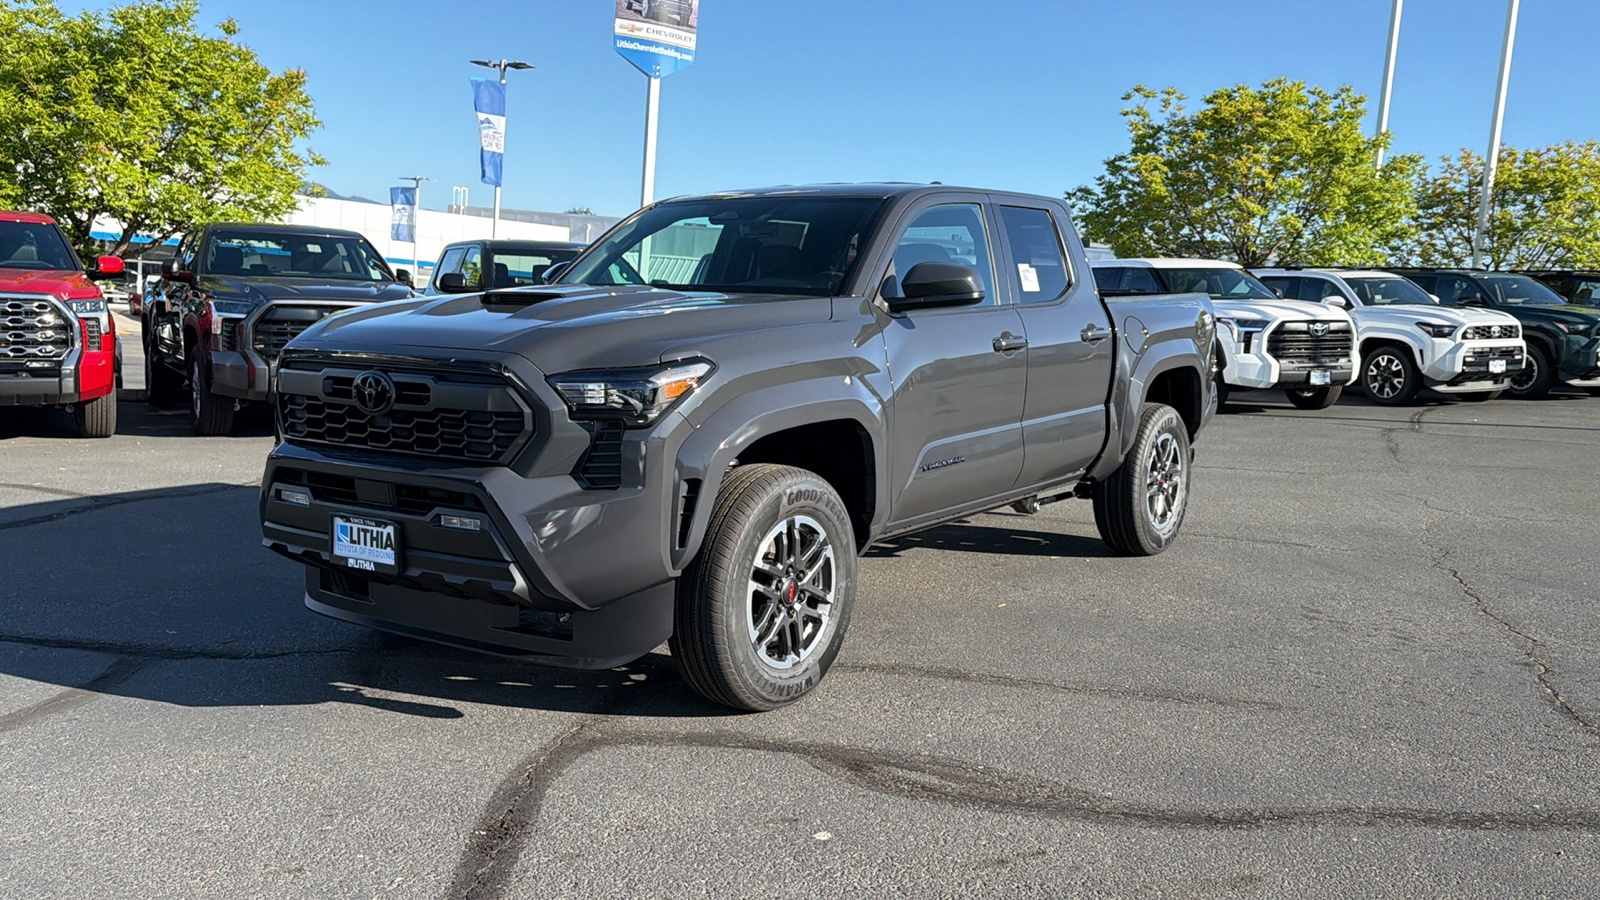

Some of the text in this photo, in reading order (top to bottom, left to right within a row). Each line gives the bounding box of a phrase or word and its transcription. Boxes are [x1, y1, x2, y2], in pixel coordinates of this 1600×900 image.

[646, 27, 692, 43] CHEVROLET
[616, 39, 693, 60] LithiaChevroletRedding.com
[349, 526, 395, 550] LITHIA
[337, 543, 394, 561] TOYOTA OF REDDING
[354, 559, 376, 571] LITHIA
